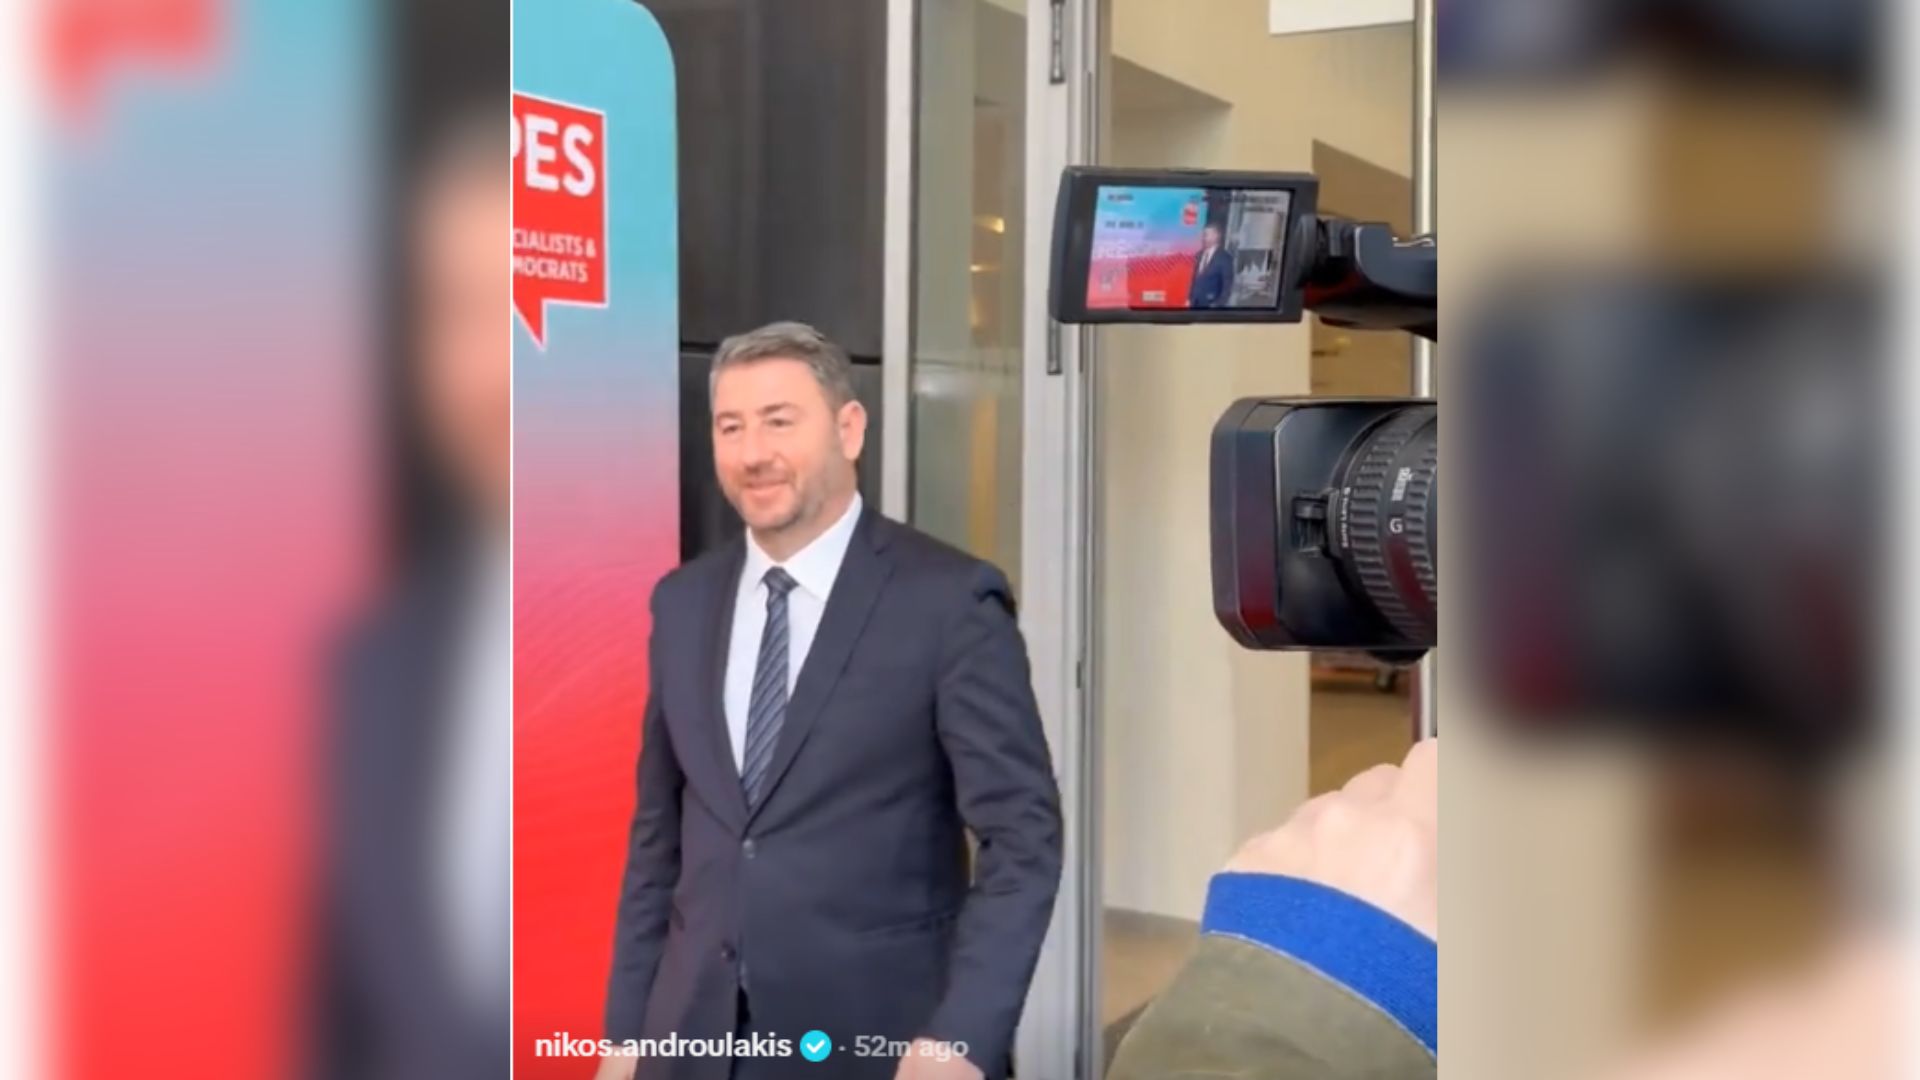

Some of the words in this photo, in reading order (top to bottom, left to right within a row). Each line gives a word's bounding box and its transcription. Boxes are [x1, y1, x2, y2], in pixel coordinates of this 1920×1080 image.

[513, 113, 595, 197] ES
[585, 238, 597, 257] &
[1389, 517, 1403, 534] G
